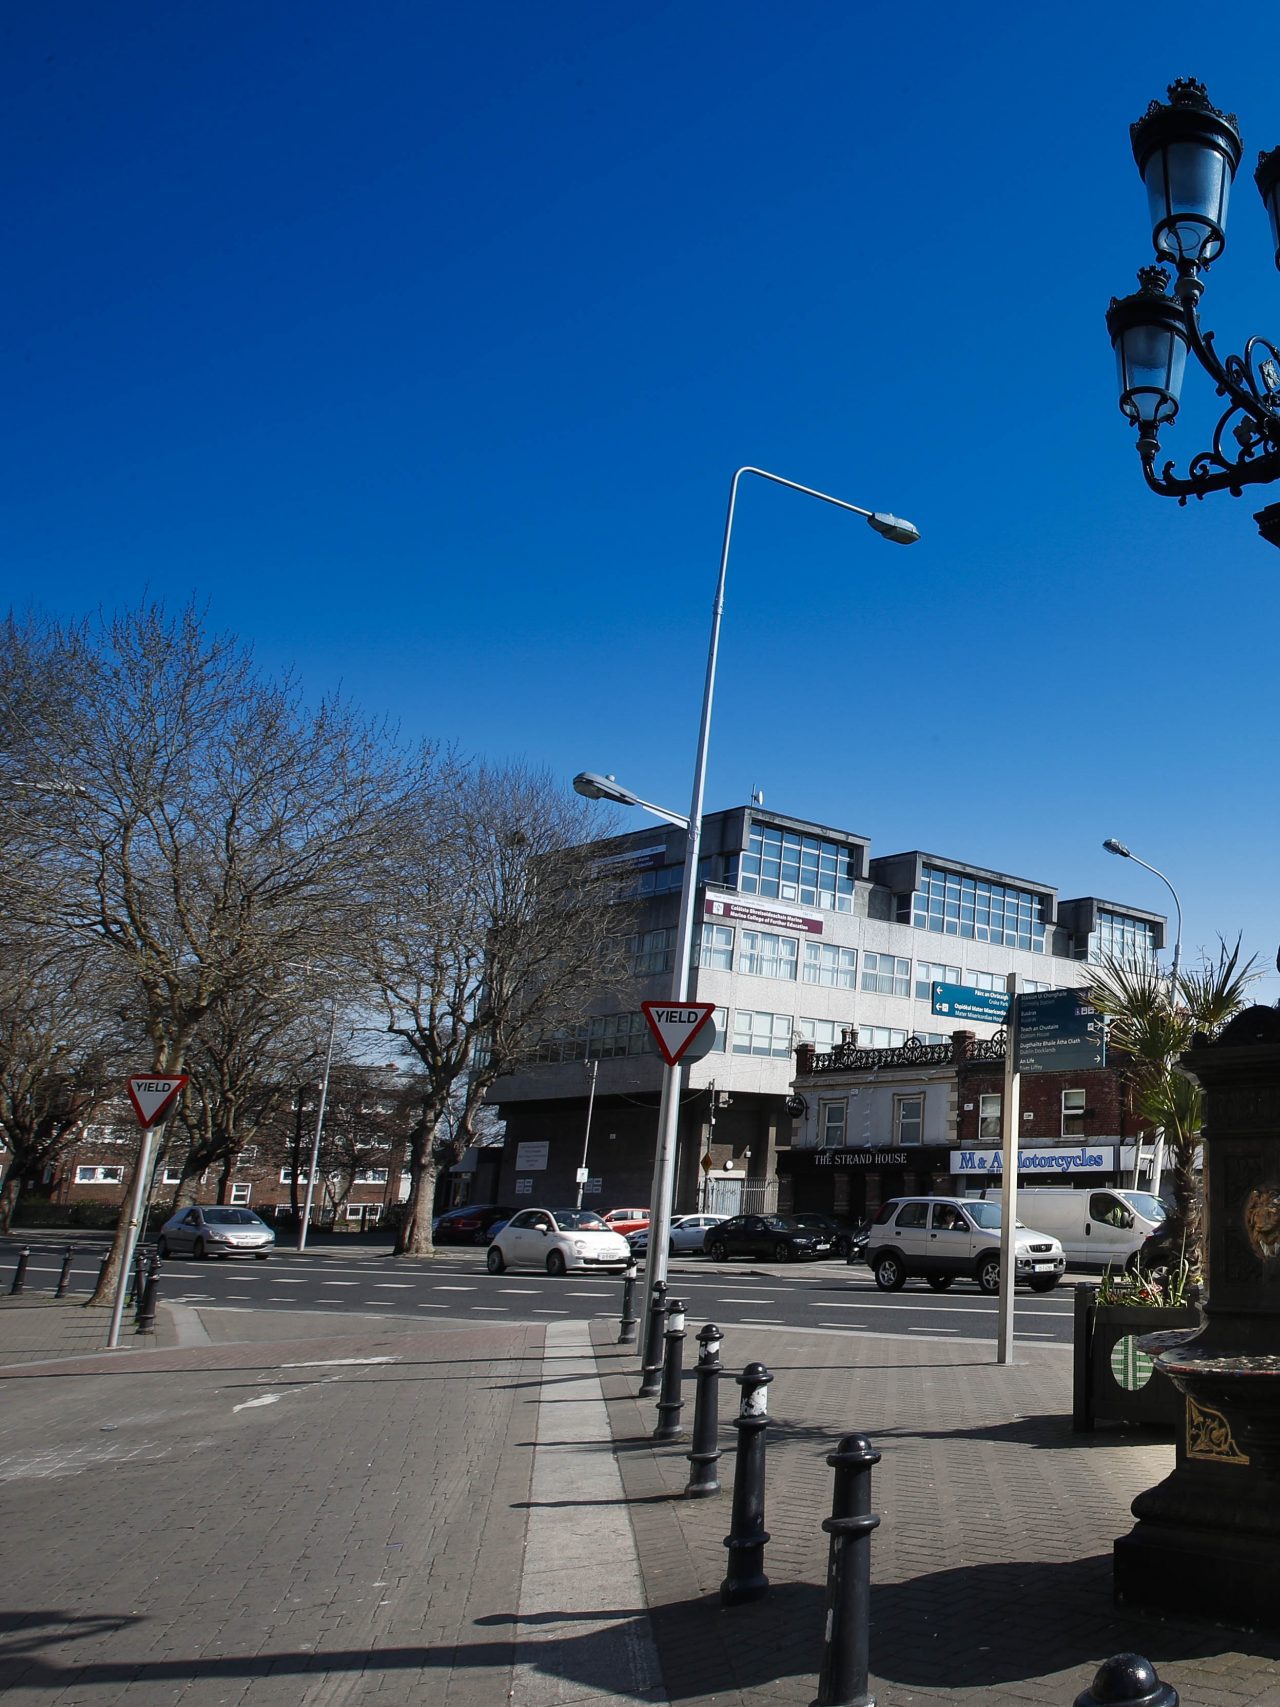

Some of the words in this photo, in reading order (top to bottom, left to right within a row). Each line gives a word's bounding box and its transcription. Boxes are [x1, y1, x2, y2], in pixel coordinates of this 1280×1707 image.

[655, 1010, 699, 1024] YIELD
[136, 1082, 172, 1093] YIELD
[814, 1154, 832, 1165] THE
[834, 1153, 873, 1165] STRAND
[874, 1152, 908, 1164] HOUSE
[959, 1151, 977, 1170] M
[977, 1157, 988, 1168] &
[989, 1151, 1003, 1169] A
